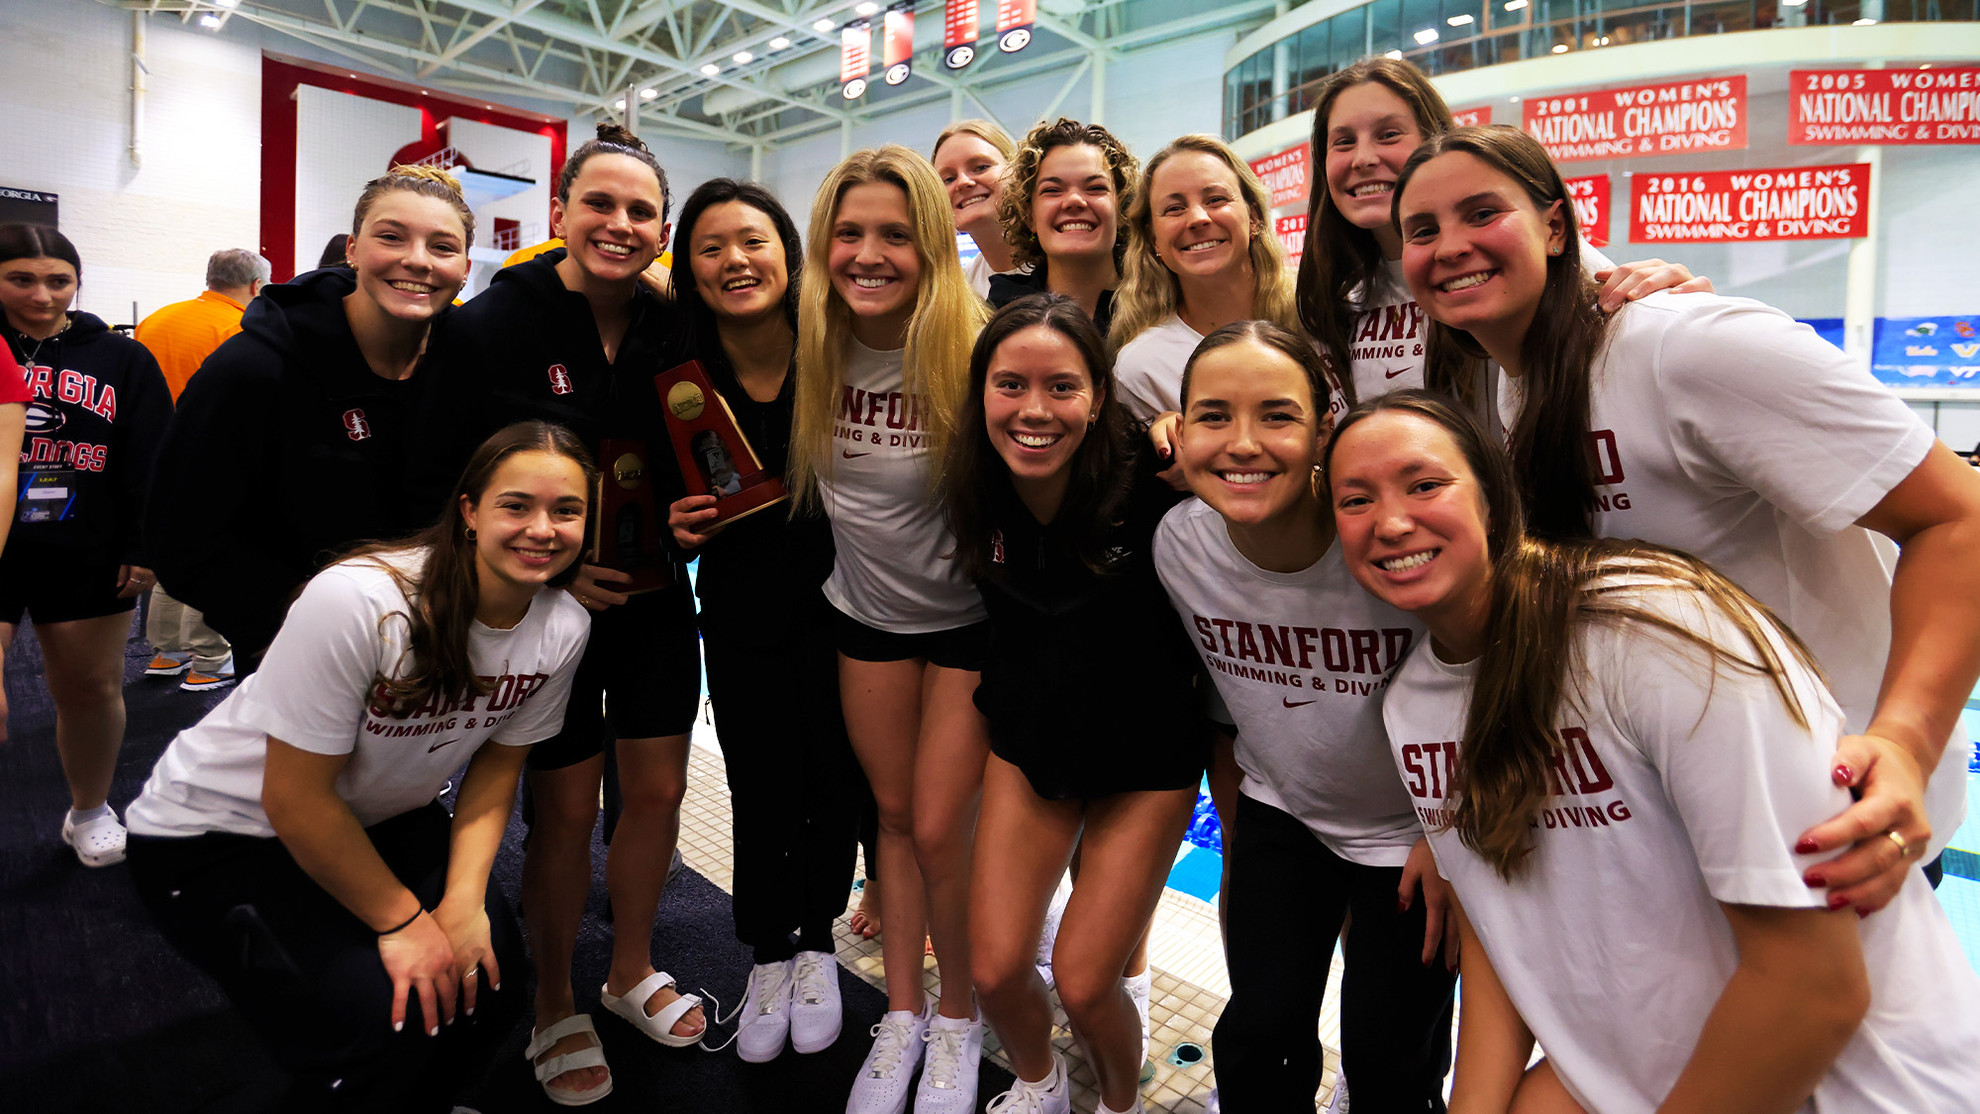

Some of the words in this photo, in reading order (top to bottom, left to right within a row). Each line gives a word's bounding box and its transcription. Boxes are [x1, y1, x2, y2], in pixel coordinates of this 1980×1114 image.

[1807, 74, 1865, 90] 2005
[1891, 72, 1980, 89] WOME
[1537, 97, 1588, 115] 2001
[1615, 81, 1730, 107] WOMEN'S
[1800, 92, 1893, 123] NATIONAL
[1901, 91, 1980, 122] CHAMPI
[1530, 111, 1616, 145] NATIONAL
[1623, 98, 1737, 137] CHAMPIONS
[1805, 125, 1909, 140] SWIMMING
[1915, 125, 1930, 139] &
[1937, 124, 1980, 139] DIVI
[1544, 138, 1633, 159] WIMMING
[1639, 137, 1652, 152] &
[1660, 130, 1730, 150] DIVING
[1648, 177, 1706, 193] 2016
[1731, 169, 1850, 191] WOMEN'S
[0, 189, 42, 202] ORGIA
[1639, 192, 1732, 223] NATIONAL
[1739, 186, 1858, 221] CHAMPIONS
[1281, 217, 1304, 231] 201
[1645, 222, 1749, 240] SWIMMING
[1755, 221, 1770, 237] &
[1777, 218, 1850, 236] DIVING
[1351, 345, 1404, 361] MMING
[1413, 343, 1423, 356] &
[871, 432, 881, 445] &
[1193, 614, 1413, 675] STANFORD
[1207, 654, 1303, 688] SWIMMING
[1312, 676, 1326, 691] &
[365, 717, 457, 738] WIMMING
[464, 717, 478, 730] &
[1542, 800, 1632, 830] DIVING
